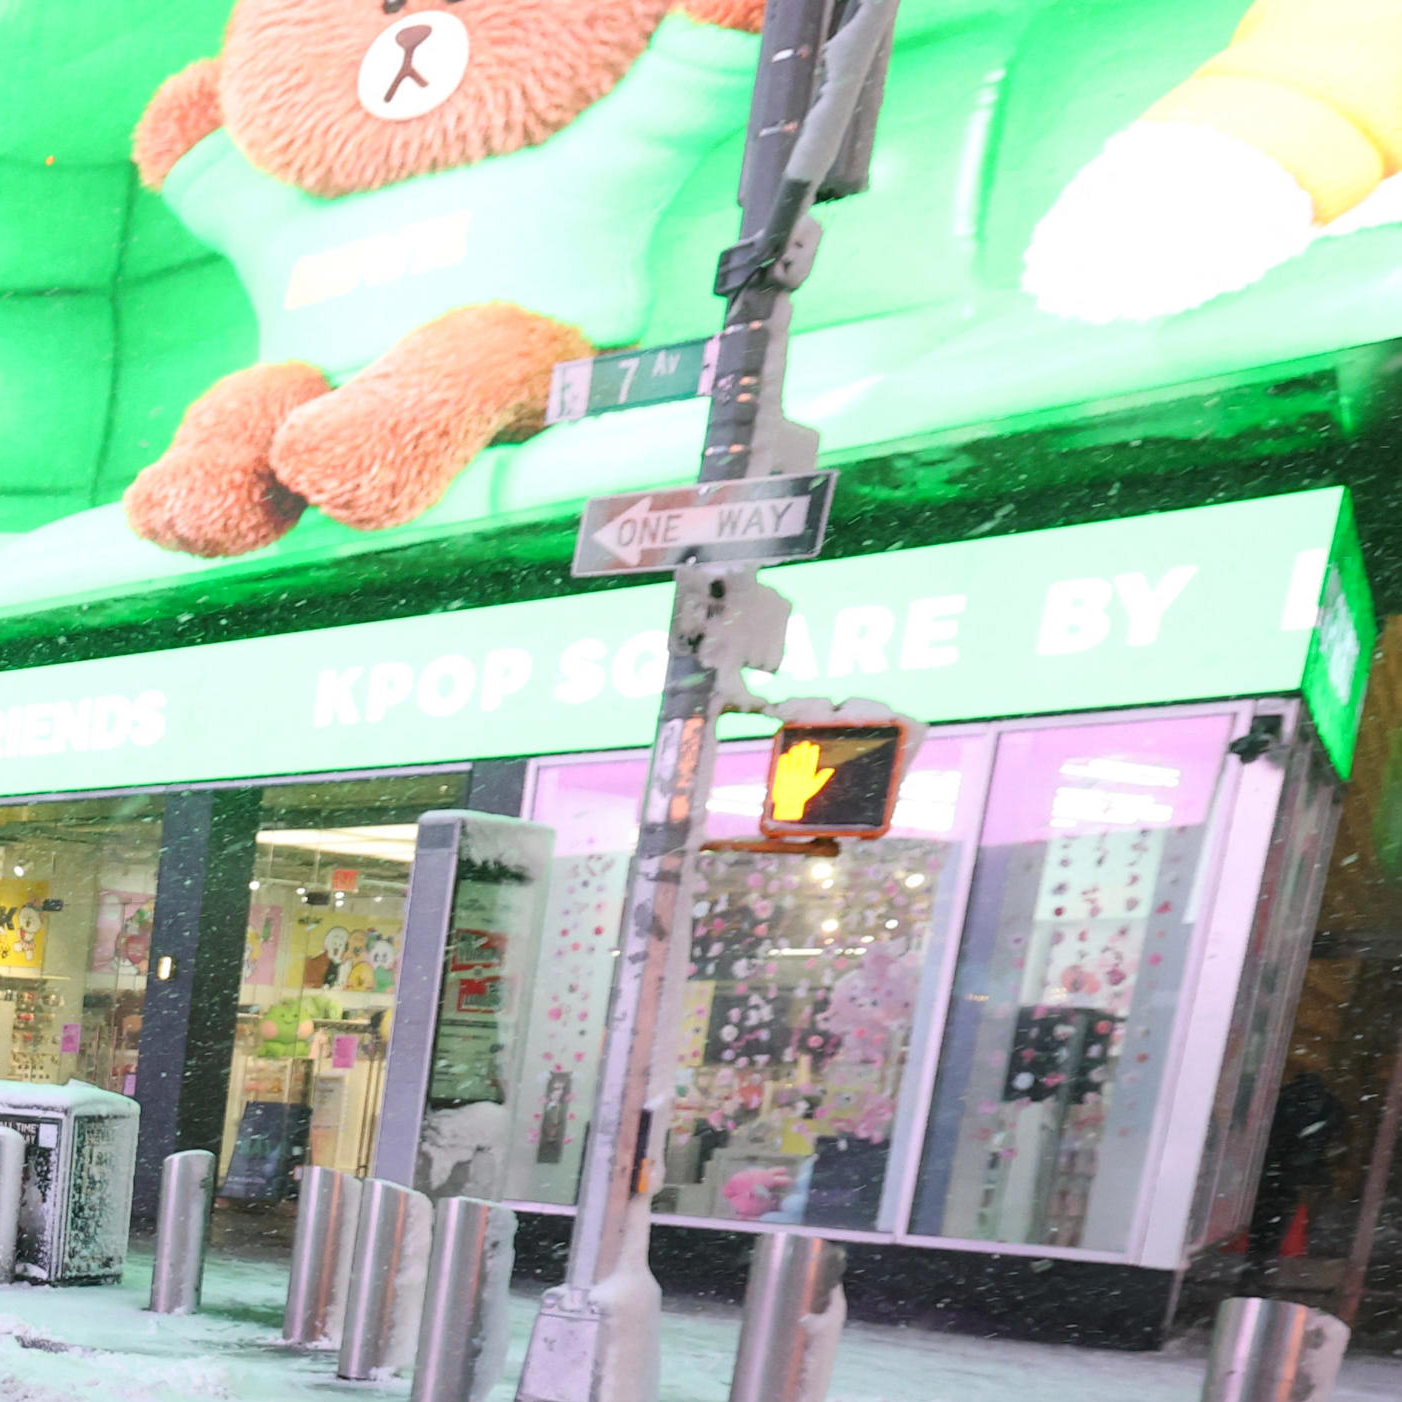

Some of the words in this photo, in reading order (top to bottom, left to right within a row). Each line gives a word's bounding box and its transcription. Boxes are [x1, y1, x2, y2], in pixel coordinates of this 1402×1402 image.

[618, 358, 640, 404] 7
[617, 513, 683, 547] ONE
[717, 501, 794, 538] WAY
[312, 648, 534, 729] KPOP
[551, 594, 968, 706] SQARE
[1036, 564, 1201, 657] BY
